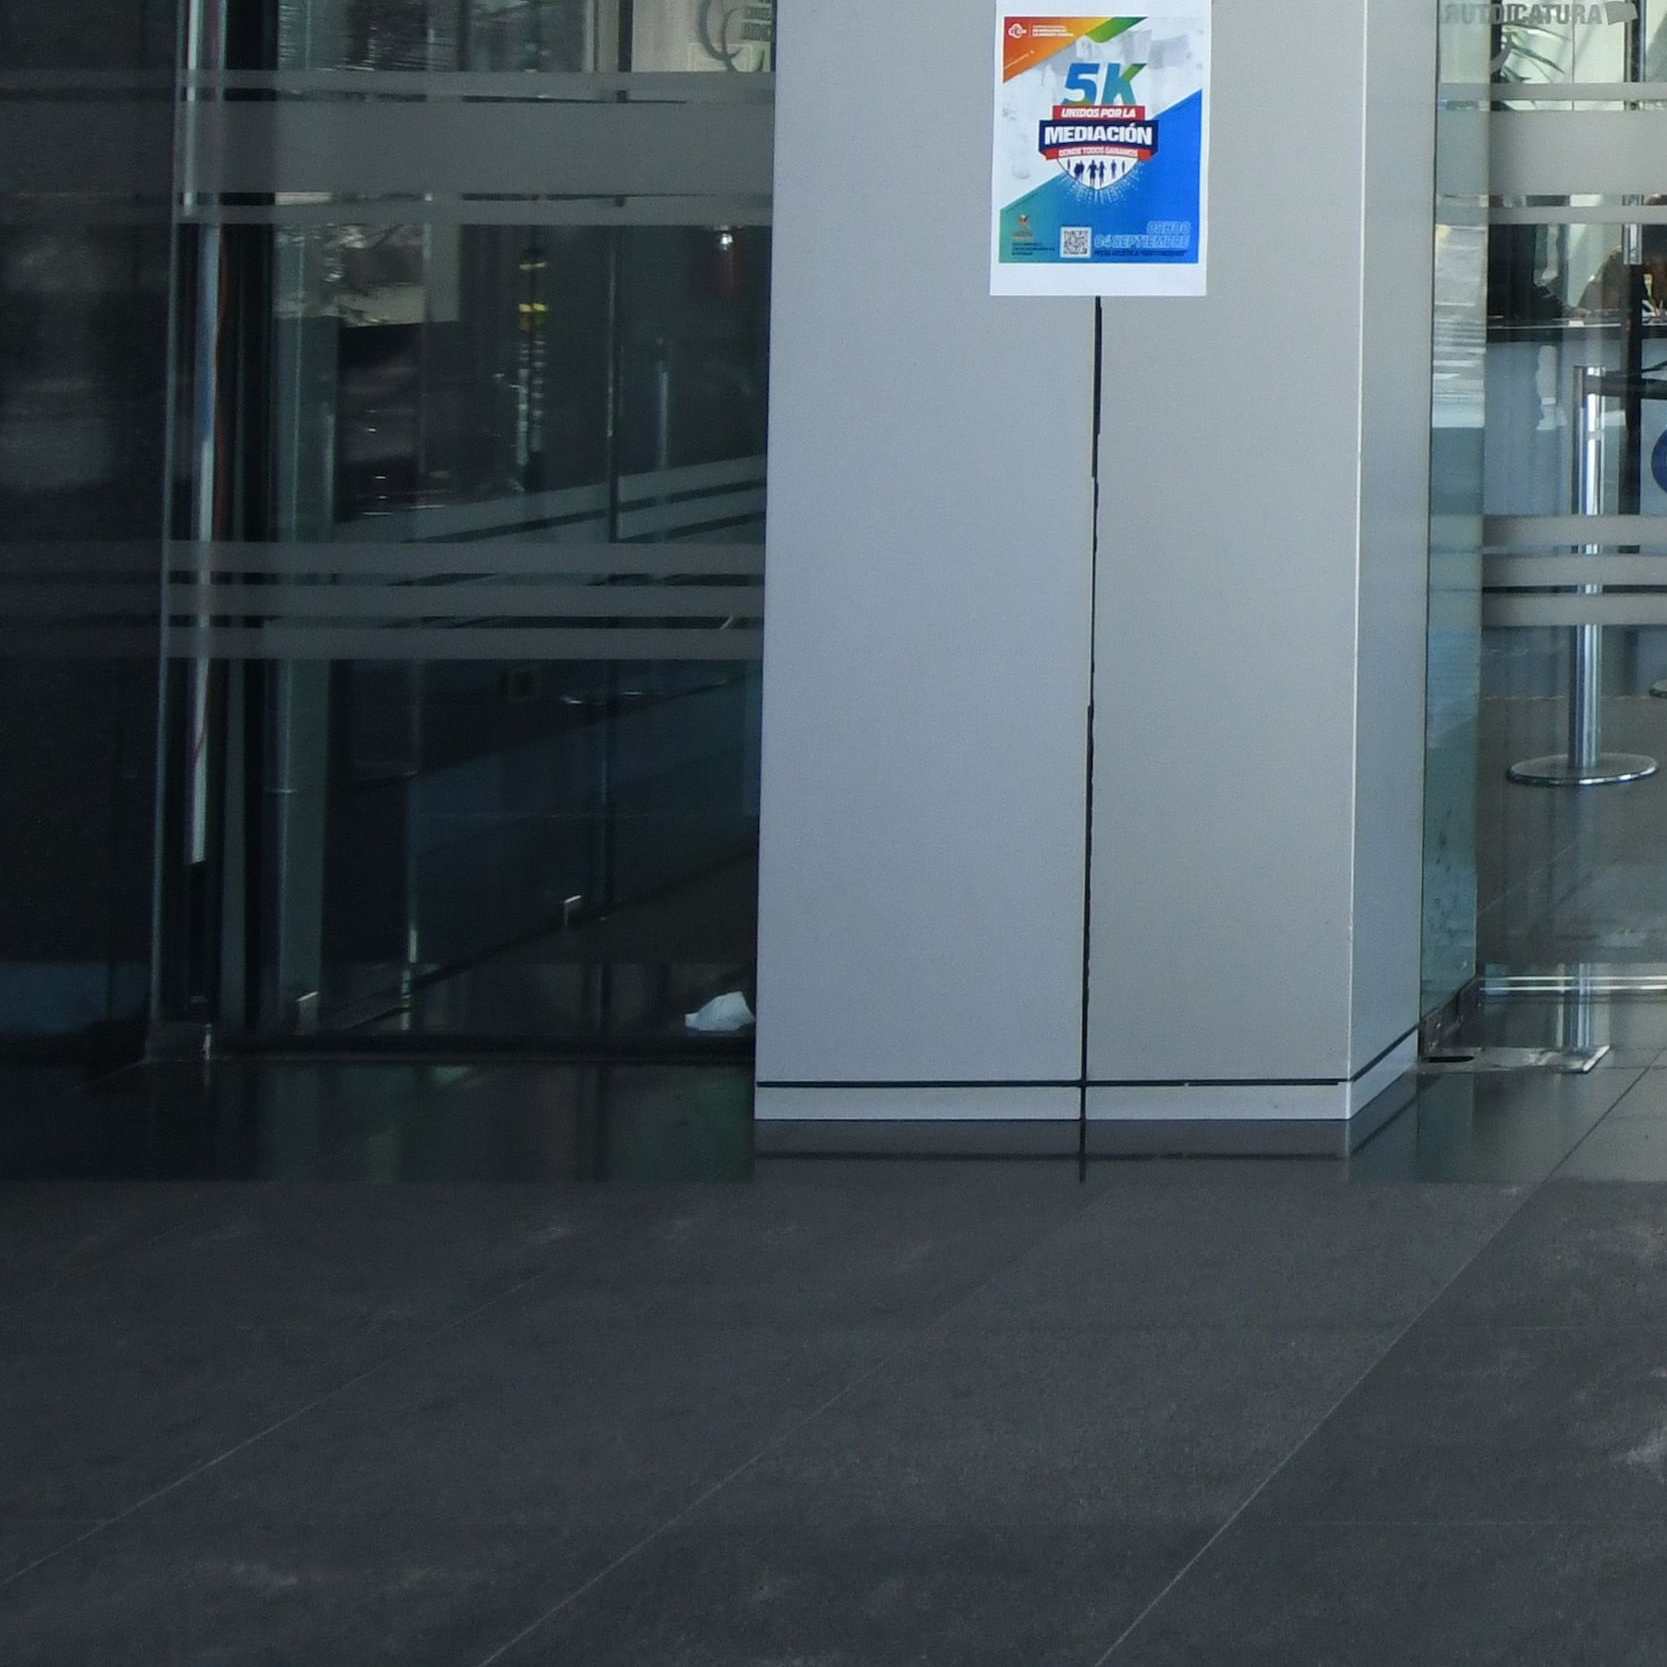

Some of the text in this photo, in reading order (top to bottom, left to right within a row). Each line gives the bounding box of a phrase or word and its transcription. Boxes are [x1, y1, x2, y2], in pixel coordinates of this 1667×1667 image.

[1061, 62, 1147, 105] 5K
[1061, 108, 1137, 118] UNIDOS POR LA
[1044, 122, 1153, 146] MEDIACIÓN
[1112, 234, 1191, 249] SEPTIEMBRE
